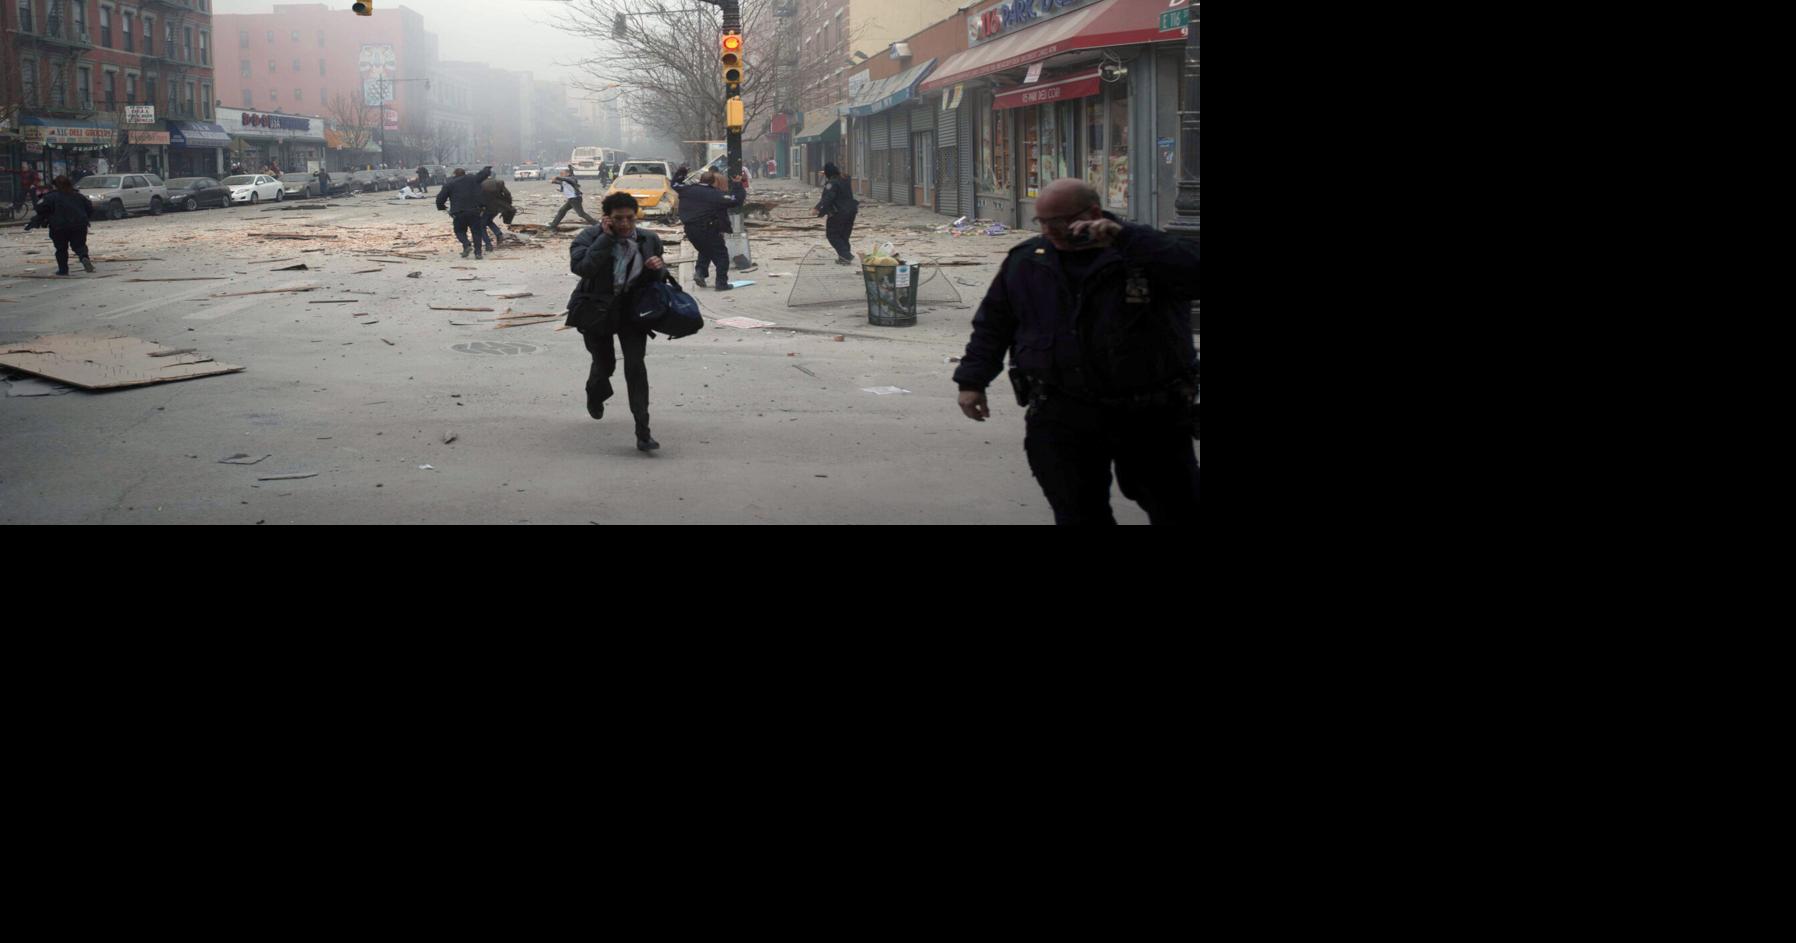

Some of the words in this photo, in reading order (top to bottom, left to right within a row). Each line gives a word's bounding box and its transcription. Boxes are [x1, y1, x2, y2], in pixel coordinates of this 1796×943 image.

[979, 8, 1002, 40] 116
[1002, 0, 1037, 27] PARK
[1163, 13, 1168, 29] E
[69, 128, 83, 137] DELI
